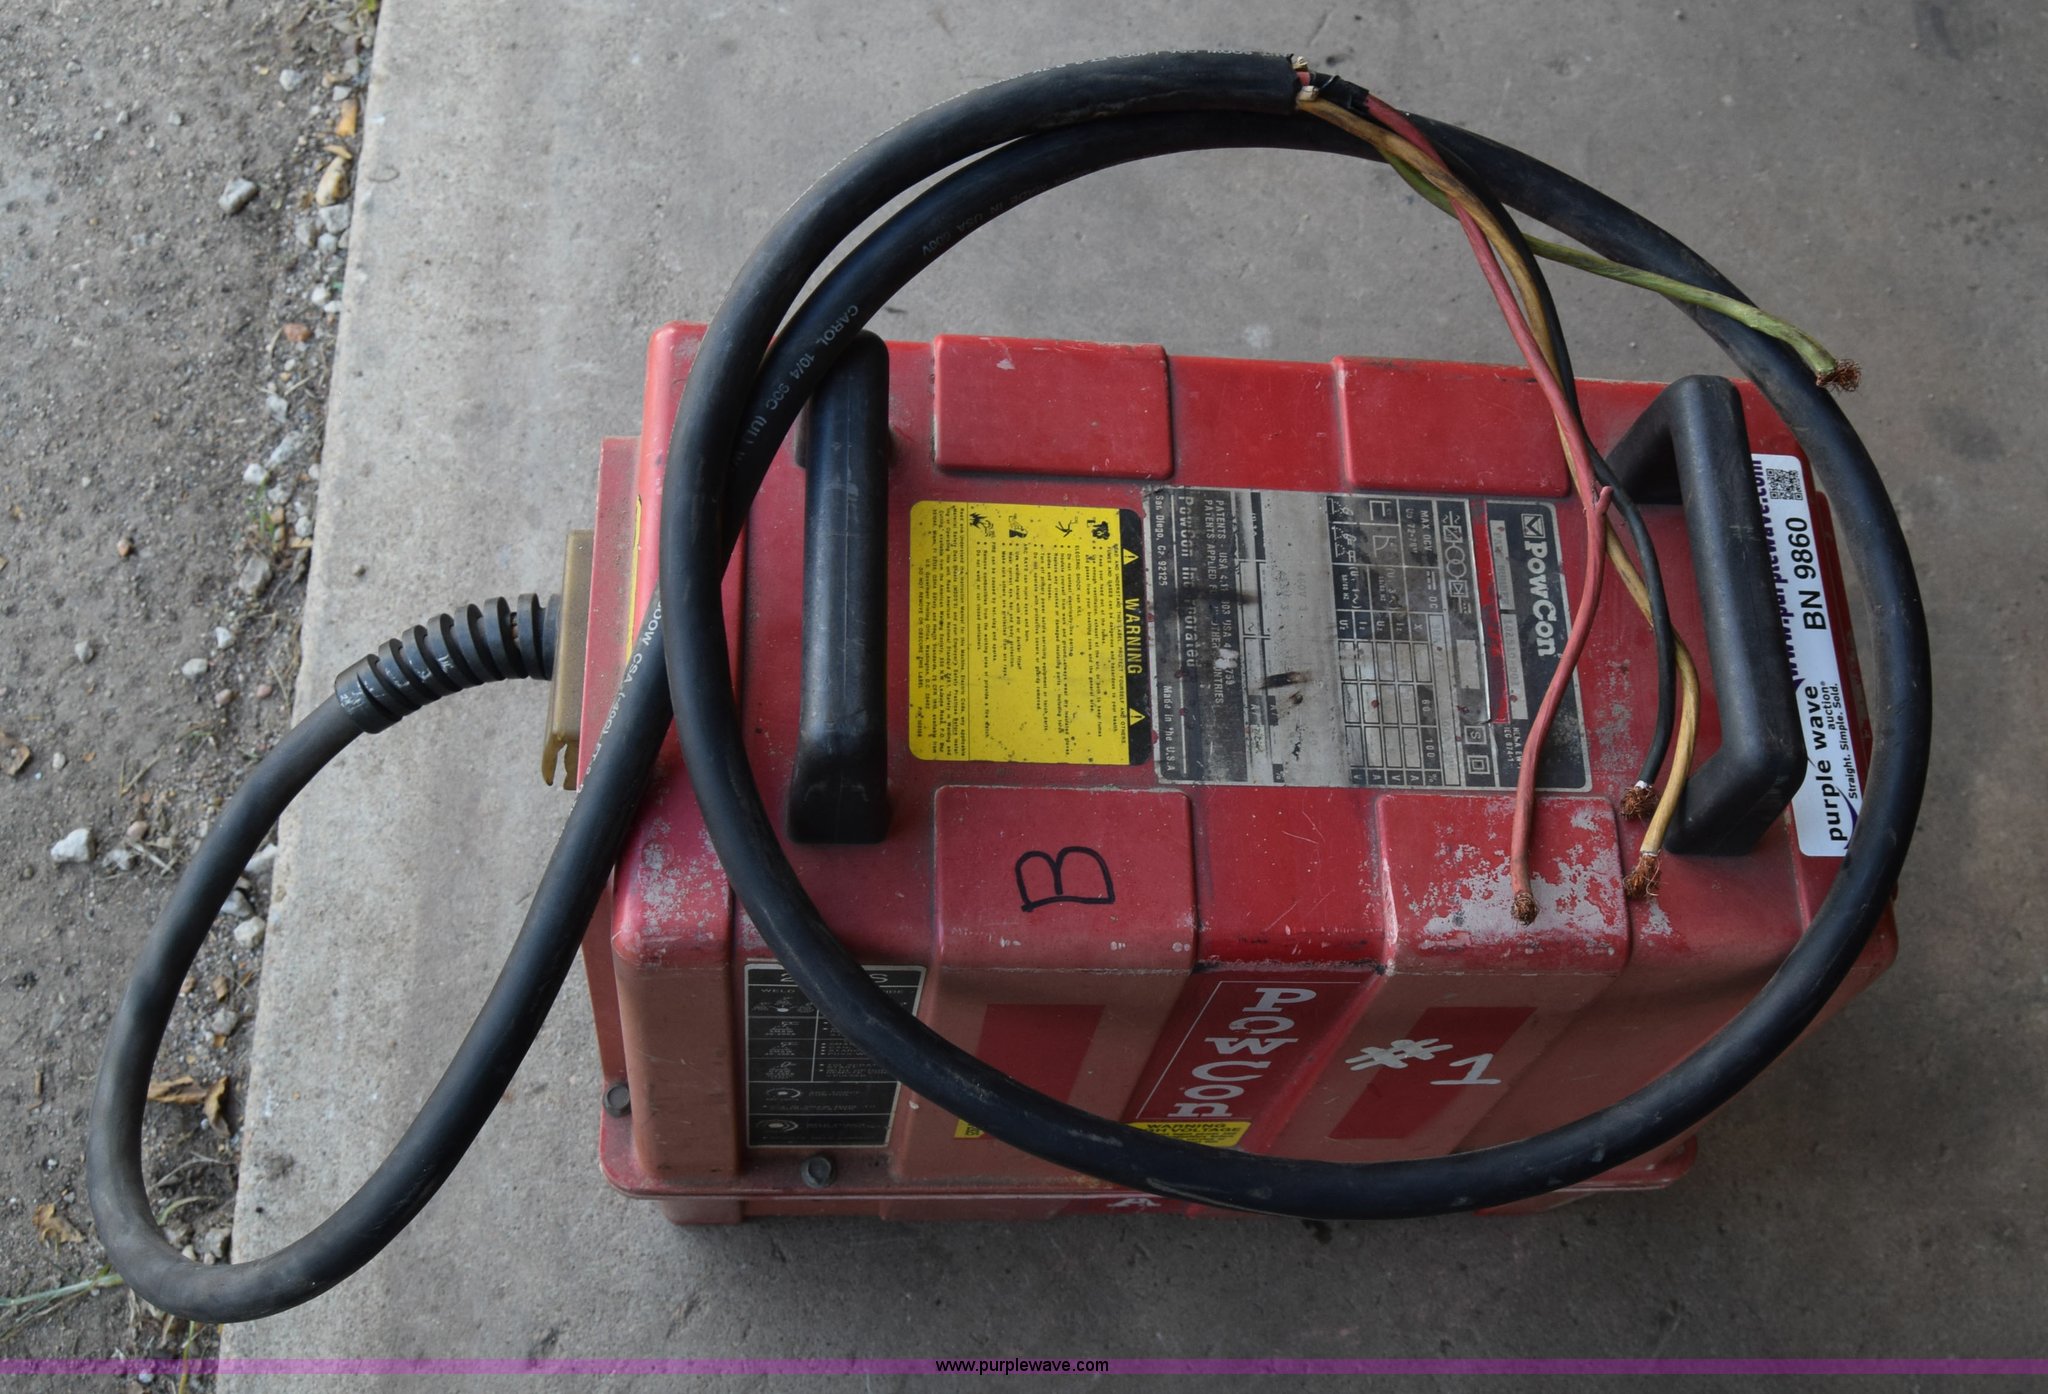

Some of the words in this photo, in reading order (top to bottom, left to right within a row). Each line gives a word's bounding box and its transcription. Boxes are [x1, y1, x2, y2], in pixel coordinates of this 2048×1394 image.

[816, 305, 858, 346] CAROL
[790, 353, 815, 380] 10/4
[1156, 495, 1164, 511] San
[1204, 499, 1214, 539] PATENTS
[1215, 500, 1226, 539] PATENTS
[1420, 510, 1431, 529] MAX
[1179, 496, 1195, 557] PowCon
[1207, 543, 1217, 580] APPLIED
[1218, 552, 1228, 569] USA
[1785, 517, 1816, 579] 9860
[1524, 541, 1558, 657] PowCon
[1799, 590, 1827, 630] BN
[1126, 598, 1142, 674] WARNING
[624, 653, 642, 684] CSA
[1163, 685, 1172, 709] Made
[1832, 683, 1842, 708] Sold.
[1164, 714, 1172, 722] in
[1165, 727, 1174, 741] the
[1471, 731, 1481, 739] S
[1804, 686, 1827, 750] wave
[1836, 711, 1849, 750] Simple.
[1425, 738, 1434, 758] 100
[1843, 754, 1857, 799] Straight.
[1815, 759, 1848, 841] purple
[1014, 846, 1117, 912] B
[1168, 986, 1318, 1117] PowCon
[1344, 1037, 1503, 1087] #1
